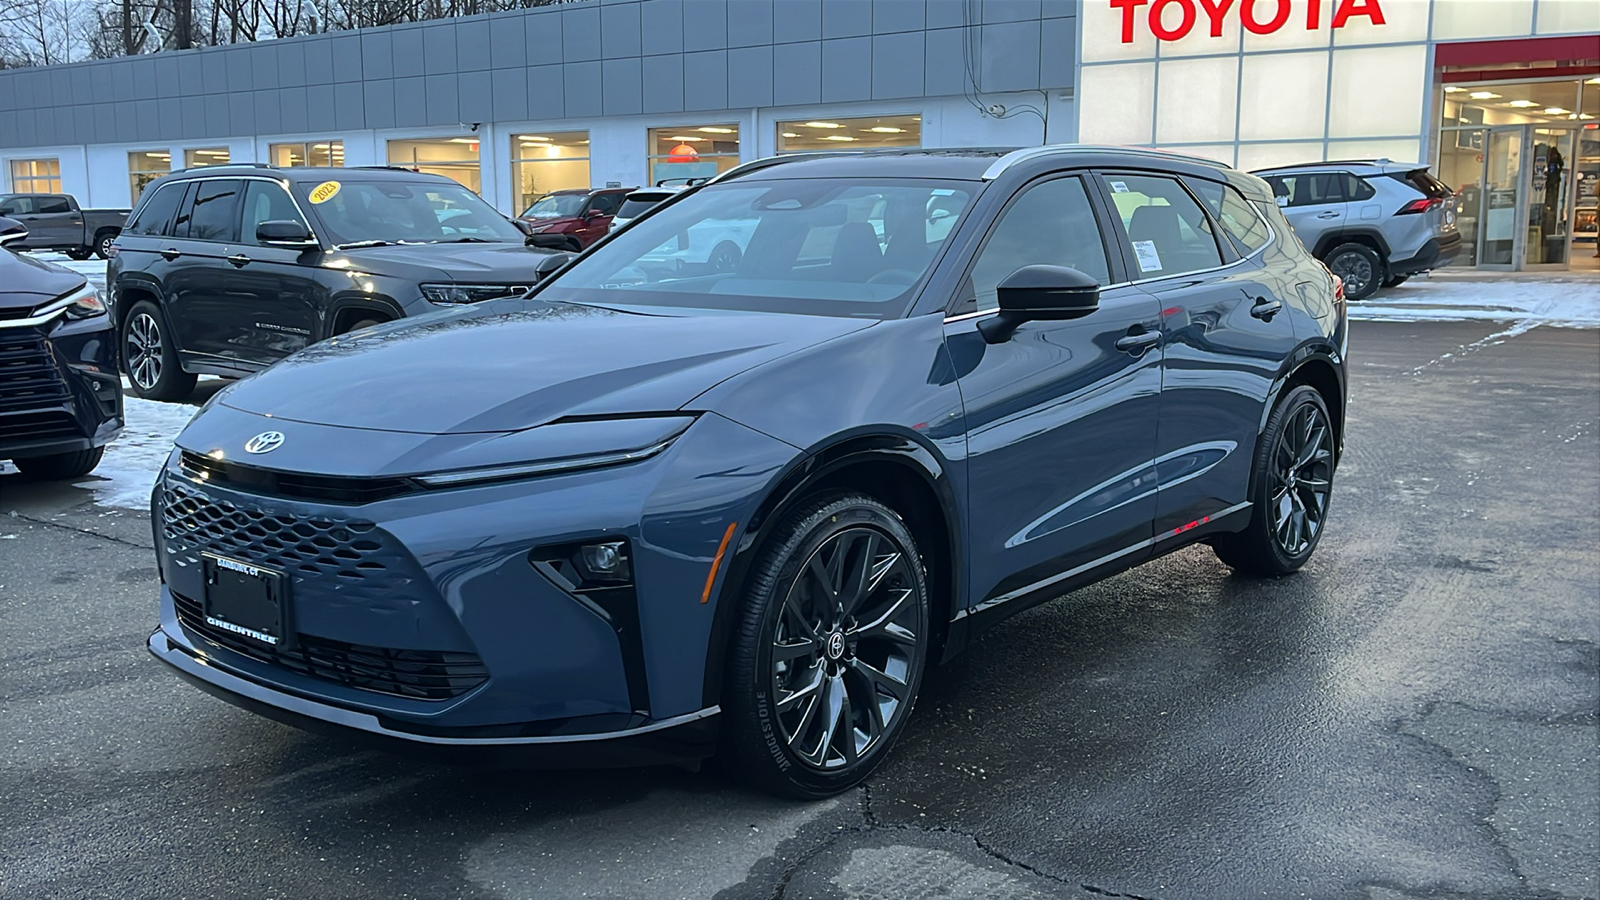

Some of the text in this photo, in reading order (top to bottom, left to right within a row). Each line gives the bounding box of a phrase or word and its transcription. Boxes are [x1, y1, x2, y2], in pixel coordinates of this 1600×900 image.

[1110, 0, 1386, 43] TOYOTA
[314, 183, 336, 201] 2023
[206, 617, 277, 645] GREENTREE
